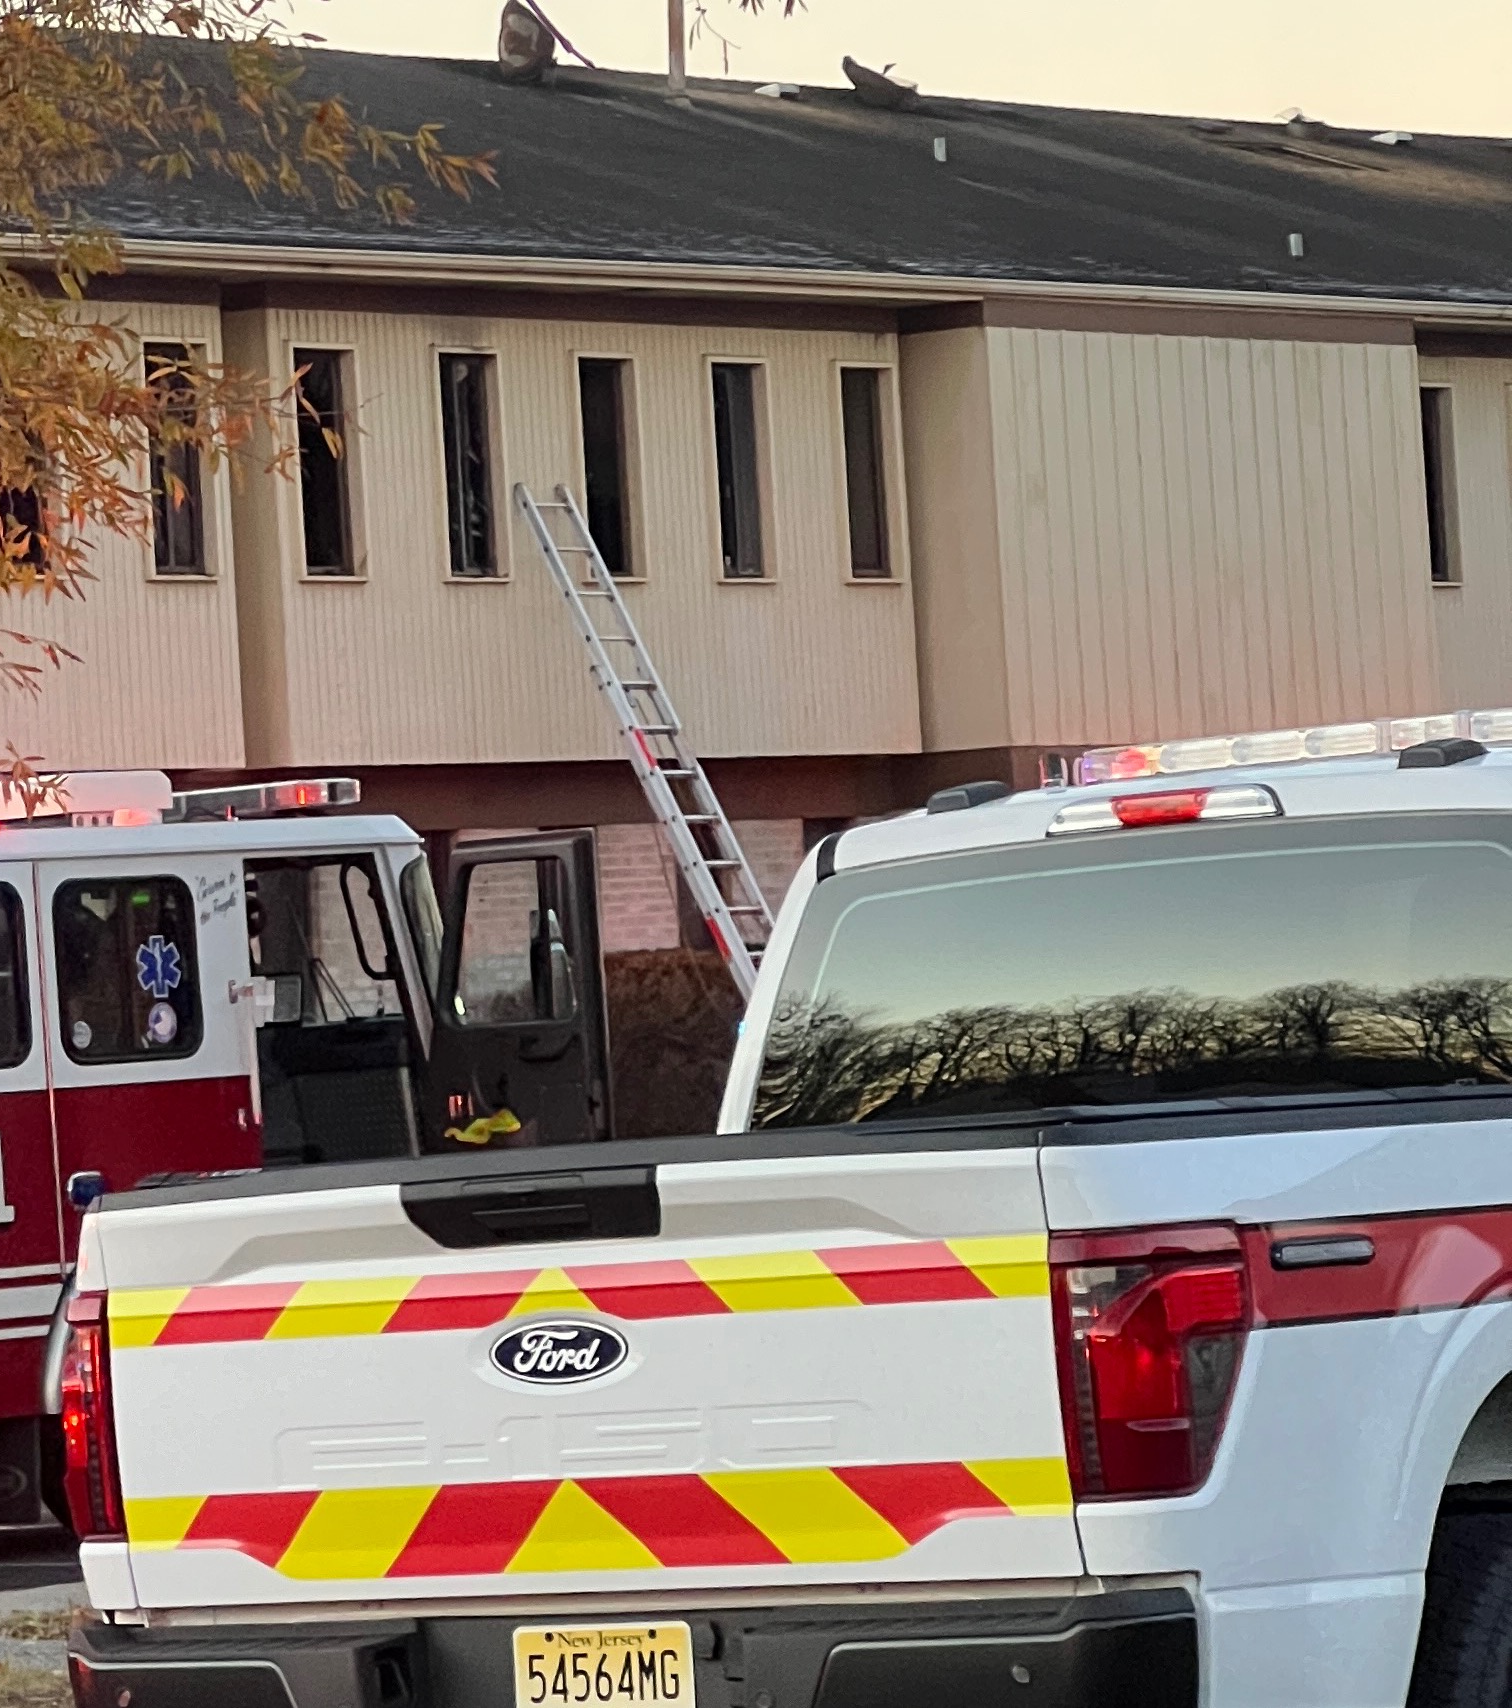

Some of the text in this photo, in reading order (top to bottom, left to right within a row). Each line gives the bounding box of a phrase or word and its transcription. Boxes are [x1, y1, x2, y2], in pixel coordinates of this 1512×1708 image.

[513, 1330, 601, 1373] Ford
[271, 1399, 878, 1490] F-150
[557, 1630, 644, 1649] New Jersey
[528, 1649, 680, 1704] 54564MG
